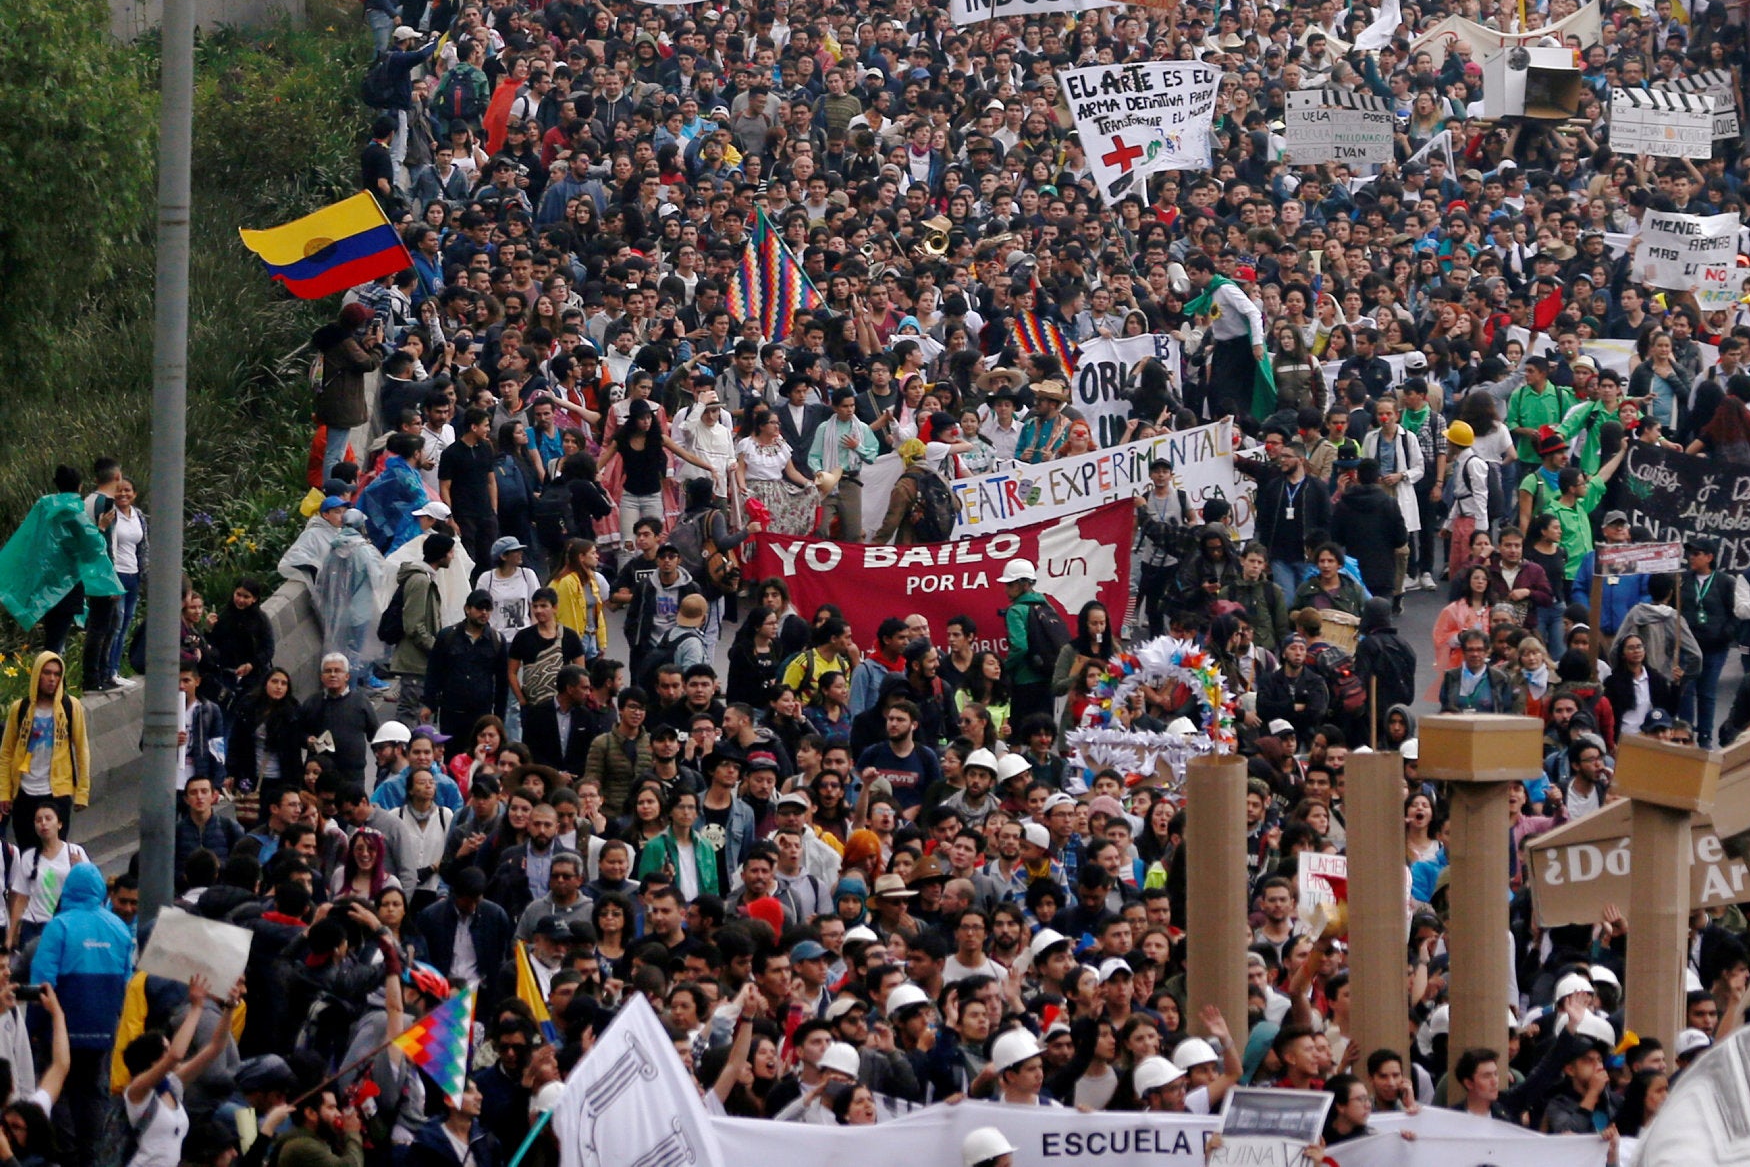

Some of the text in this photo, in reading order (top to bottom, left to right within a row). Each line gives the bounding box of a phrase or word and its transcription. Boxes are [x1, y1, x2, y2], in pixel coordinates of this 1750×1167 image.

[1066, 74, 1097, 100] EL
[1163, 70, 1183, 87] ES
[1077, 99, 1120, 121] ARMA
[1172, 111, 1185, 124] EL
[1649, 247, 1679, 261] MAS
[1704, 268, 1728, 282] NO
[769, 533, 1021, 576] YO BAILO
[1047, 555, 1087, 579] un
[906, 572, 989, 595] POR LA
[1042, 1130, 1193, 1157] ESCUELA
